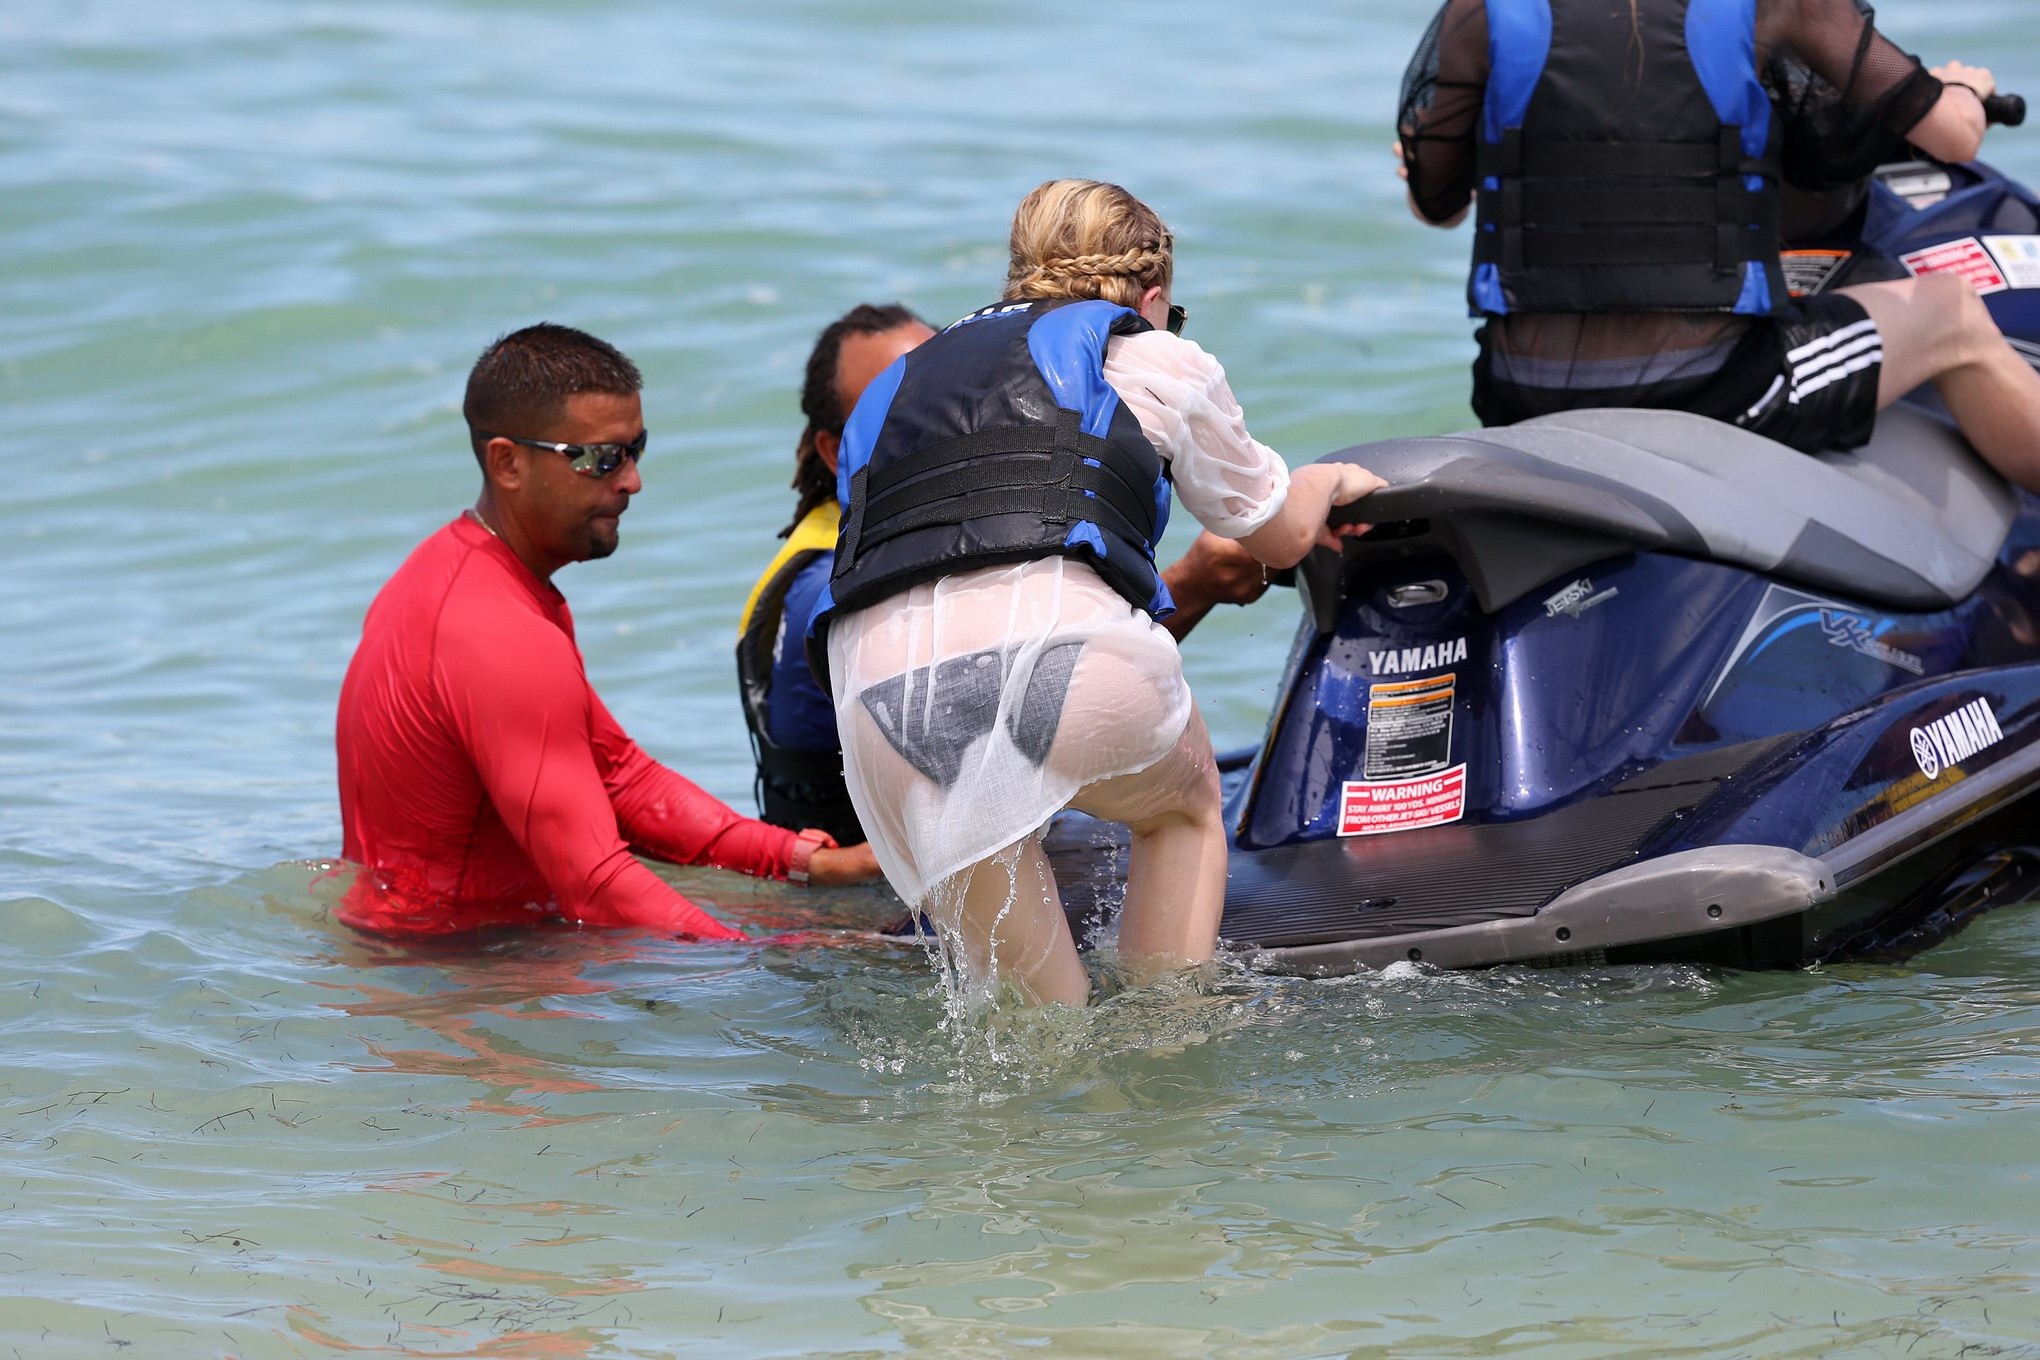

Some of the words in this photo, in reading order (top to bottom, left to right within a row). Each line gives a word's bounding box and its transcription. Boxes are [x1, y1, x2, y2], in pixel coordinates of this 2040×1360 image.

[1819, 608, 1873, 649] VX
[1368, 637, 1467, 675] YAMAHA
[1924, 696, 2004, 768] YAMAHA
[1371, 779, 1443, 802] WARNING
[1345, 815, 1371, 824] FROM
[1371, 811, 1399, 823] OTHER
[1347, 803, 1368, 814] STAY
[1368, 802, 1393, 813] AWAY
